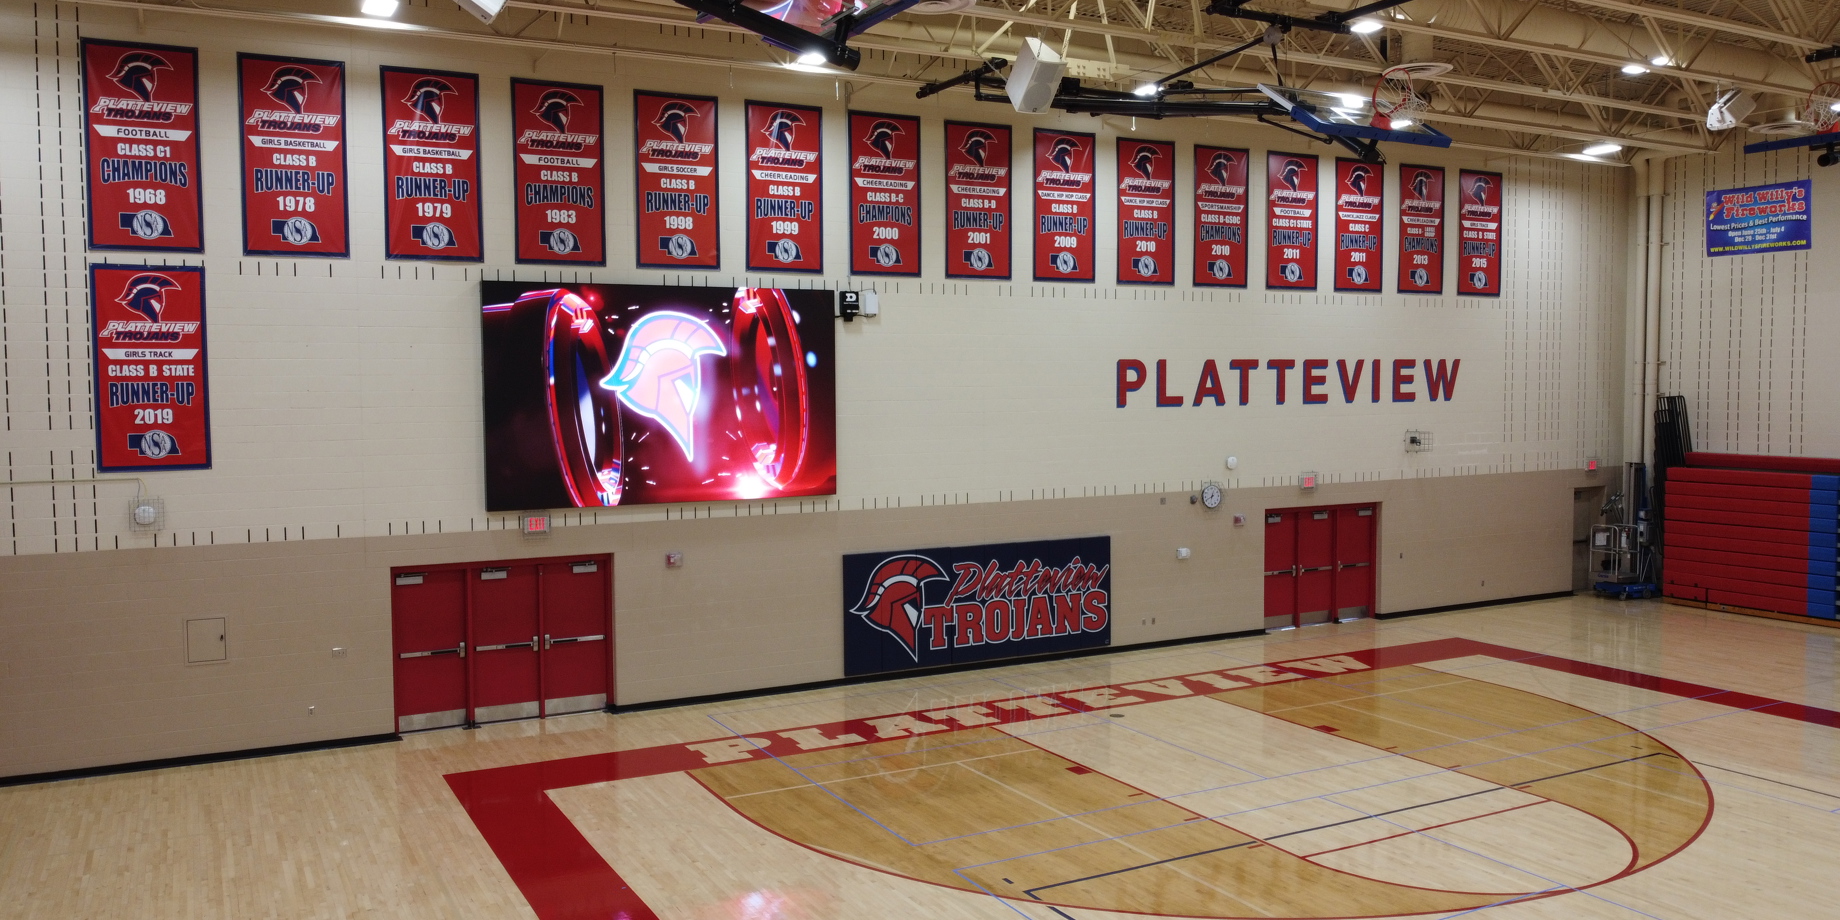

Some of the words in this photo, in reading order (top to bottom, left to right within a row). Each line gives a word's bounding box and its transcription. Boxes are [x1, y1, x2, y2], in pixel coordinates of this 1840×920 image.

[90, 97, 193, 116] PLATTEVIEW
[104, 108, 174, 123] TROJANS
[246, 109, 340, 127] PLATTEVIEW
[117, 128, 170, 139] FOOTBALL
[259, 120, 322, 134] TROJANS
[388, 120, 474, 136] PLATTEVIEW
[400, 129, 458, 142] TROJANS
[518, 130, 598, 144] PLATTEVIEW
[261, 138, 281, 147] GIRLS
[284, 140, 326, 149] BASKETBALL
[529, 139, 583, 152] TROJANS
[640, 140, 714, 154] PLATTEVIEW
[117, 143, 154, 157] CLASS
[157, 145, 170, 158] C1
[402, 147, 421, 155] GIRLS
[423, 149, 461, 157] BASKETBALL
[650, 150, 699, 160] TROJANS
[751, 147, 818, 162] PLATTEVIEW
[273, 154, 307, 166] CLASS
[309, 156, 316, 166] B
[538, 157, 580, 166] FOOTBALL
[760, 156, 805, 168] TROJANS
[853, 156, 916, 170] PLATTEVIEW
[101, 158, 188, 188] CHAMPIONS
[413, 162, 443, 173] CLASS
[445, 164, 452, 174] B
[862, 165, 903, 175] TROJANS
[949, 164, 1008, 177] PLATTEVIEW
[255, 168, 335, 195] RUNNER-UP
[541, 170, 570, 181] CLASS
[572, 172, 578, 182] B
[760, 172, 808, 181] CHEERLEADING
[956, 172, 996, 182] TROJANS
[1037, 170, 1092, 182] PLATTEVIEW
[396, 176, 469, 201] RUNNER-UP
[661, 178, 687, 189] CLASS
[689, 180, 695, 189] B
[863, 180, 908, 188] CHEERLEADING
[1044, 178, 1082, 188] TROJANS
[1120, 177, 1171, 189] PLATTEVIEW
[1127, 185, 1162, 194] TROJANS
[1197, 183, 1245, 195] PLATTEVIEW
[127, 188, 166, 204] 1968
[525, 183, 594, 208] CHAMPIONS
[769, 185, 793, 195] CLASS
[794, 187, 800, 196] B
[867, 192, 890, 201] CLASS
[891, 193, 904, 202] B-C
[1203, 191, 1236, 200] TROJANS
[1270, 189, 1315, 200] PLATTEVIEW
[1722, 192, 1754, 205] Wild
[1756, 187, 1805, 203] Willy's
[276, 196, 315, 211] 1978
[646, 192, 709, 215] RUNNER-UP
[755, 198, 813, 221] RUNNER-UP
[962, 198, 983, 207] CLASS
[985, 200, 996, 208] B-D
[1052, 204, 1072, 212] CLASS
[1073, 205, 1077, 213] B
[1724, 200, 1805, 219] Fireworks
[416, 203, 451, 218] 1979
[545, 210, 576, 223] 1983
[859, 204, 912, 226] CHAMPIONS
[1134, 209, 1153, 218] CLASS
[1154, 210, 1158, 218] B
[664, 216, 693, 229] 1998
[953, 210, 1003, 232] RUNNER-UP
[1201, 214, 1218, 222] CLASS
[1273, 218, 1289, 226] CLASS
[1296, 220, 1312, 228] STATE
[1769, 215, 1807, 223] Performance
[771, 221, 798, 235] 1999
[1040, 215, 1088, 235] RUNNER-UP
[1123, 221, 1168, 240] RUNNER-UP
[1349, 223, 1364, 231] CLASS
[873, 227, 899, 239] 2000
[968, 232, 990, 244] 2001
[1200, 225, 1240, 244] CHAMPIONS
[1272, 229, 1312, 248] RUNNER-UP
[1054, 236, 1077, 248] 2009
[1136, 241, 1156, 252] 2010
[1340, 233, 1377, 251] RUNNER-UP
[1404, 236, 1438, 254] CHAMPIONS
[1212, 245, 1230, 256] 2010
[1284, 248, 1300, 259] 2011
[1463, 241, 1496, 258] RUNNER-UP
[1351, 252, 1366, 262] 2011
[1413, 255, 1428, 264] 2013
[1472, 258, 1487, 268] 2015
[100, 321, 200, 338] PLATTEVIEW
[113, 332, 182, 342] TROJANS
[108, 365, 144, 376] CLASS
[149, 365, 157, 376] B
[163, 365, 194, 376] STATE
[1116, 359, 1461, 408] PLATTEVIEW
[109, 382, 194, 408] RUNNER-UP
[134, 409, 173, 424] 2019
[529, 517, 546, 531] EXIT
[944, 556, 1109, 609] Platteview
[922, 589, 1108, 649] TROJANS
[685, 655, 1372, 764] PLATTEVIEW
